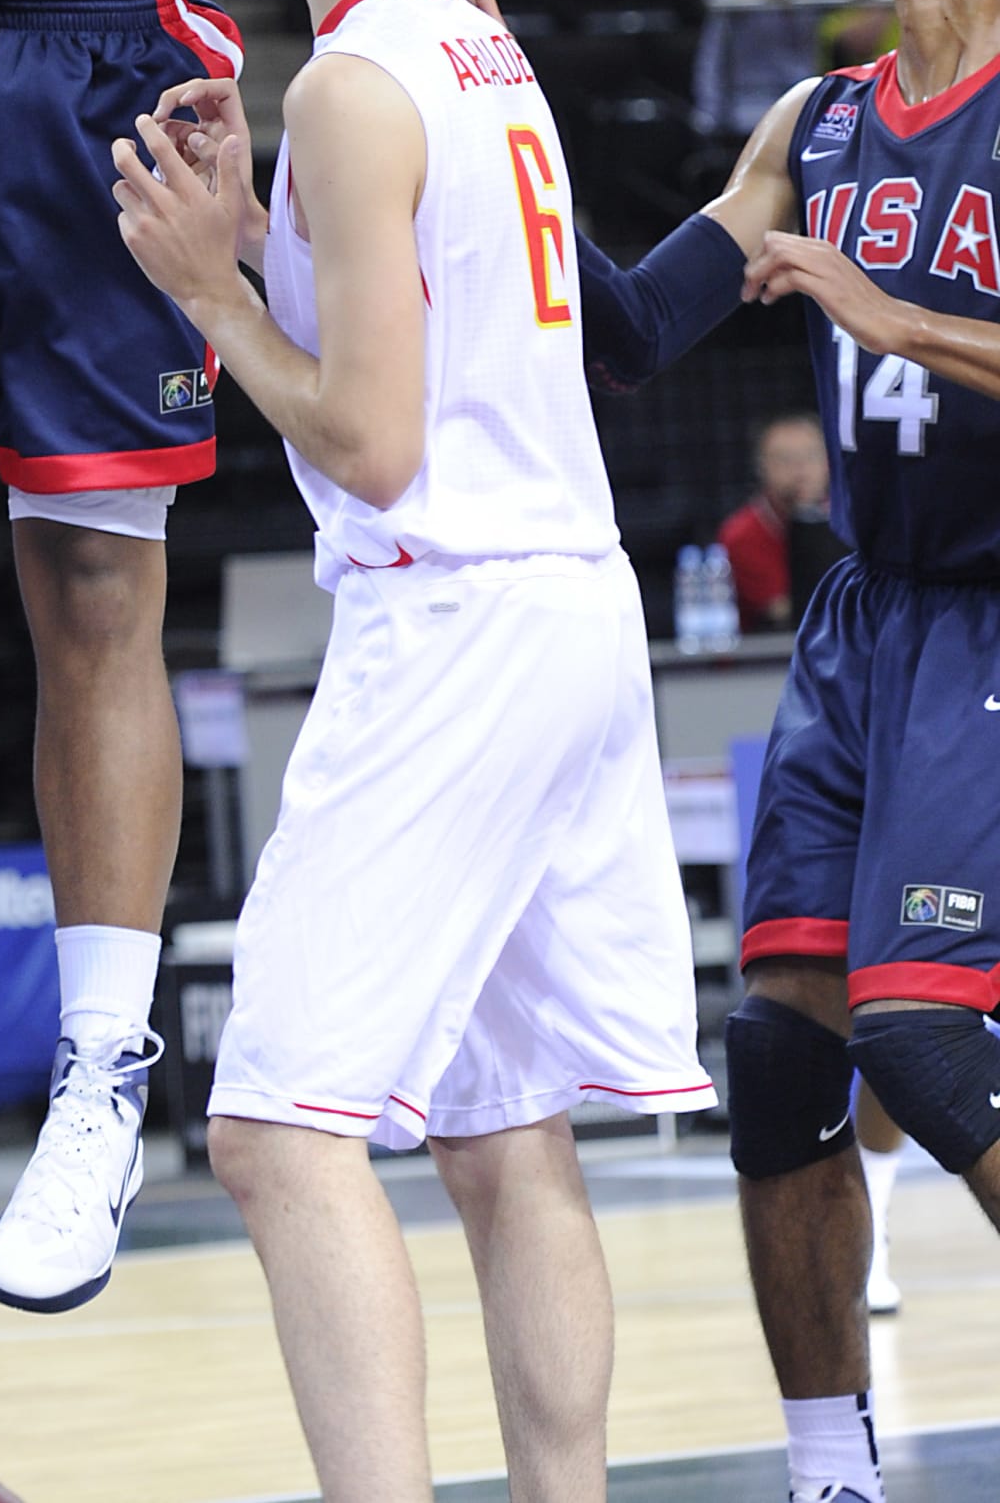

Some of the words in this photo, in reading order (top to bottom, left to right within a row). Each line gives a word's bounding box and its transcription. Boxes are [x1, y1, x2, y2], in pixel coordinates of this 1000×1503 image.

[506, 123, 573, 330] 6
[806, 177, 1000, 297] USA
[832, 320, 940, 458] 14
[948, 893, 977, 912] FIBA
